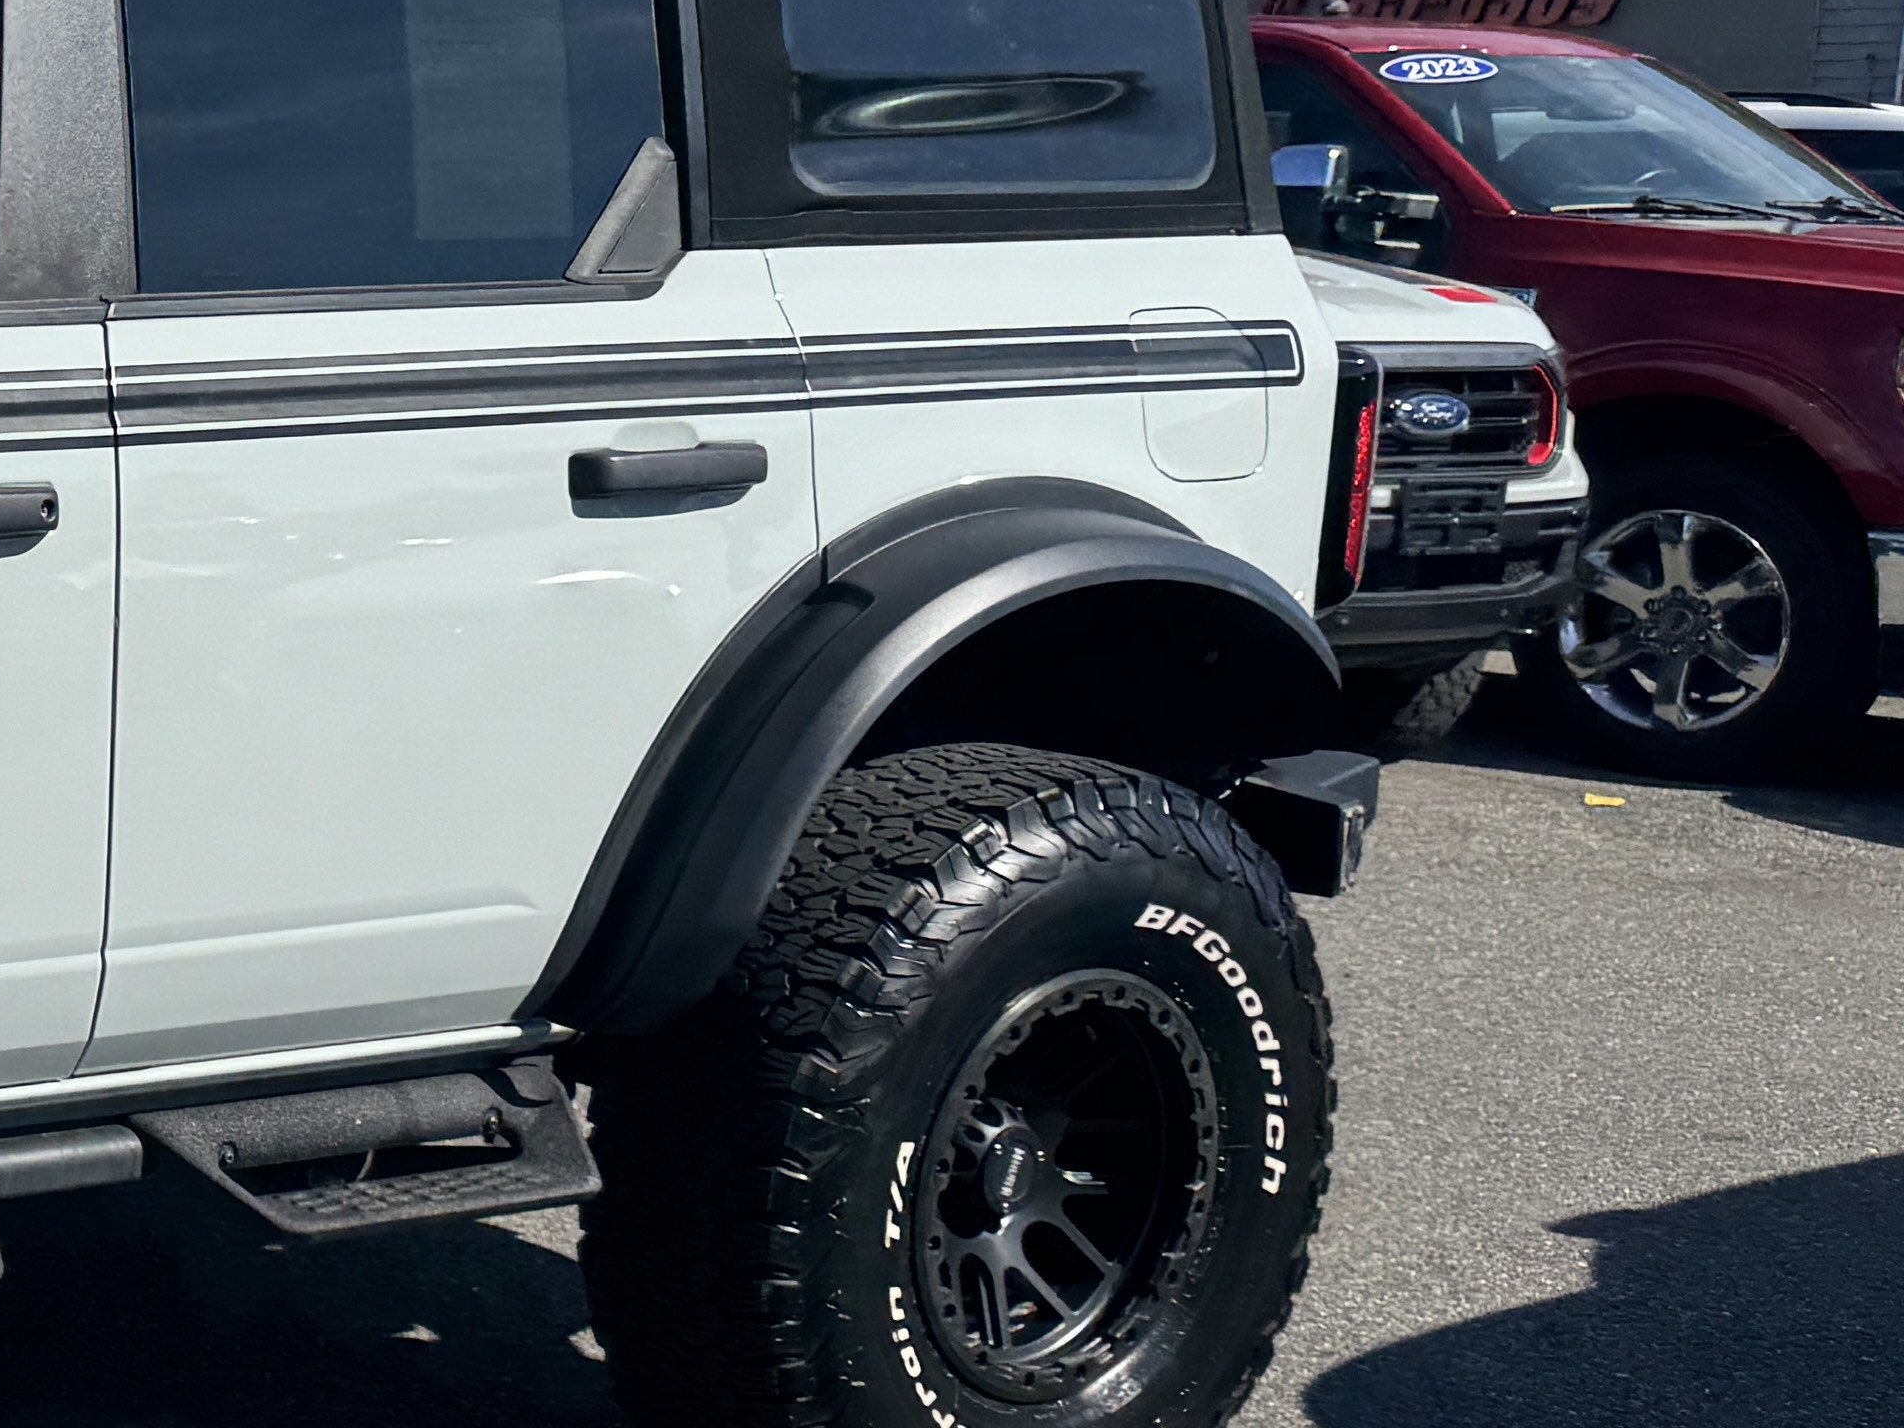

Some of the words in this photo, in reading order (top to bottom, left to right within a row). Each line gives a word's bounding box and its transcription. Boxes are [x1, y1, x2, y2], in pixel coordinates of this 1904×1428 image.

[1401, 55, 1481, 80] 2023
[1134, 902, 1289, 1195] BFGoodrich
[884, 1141, 916, 1249] T/A
